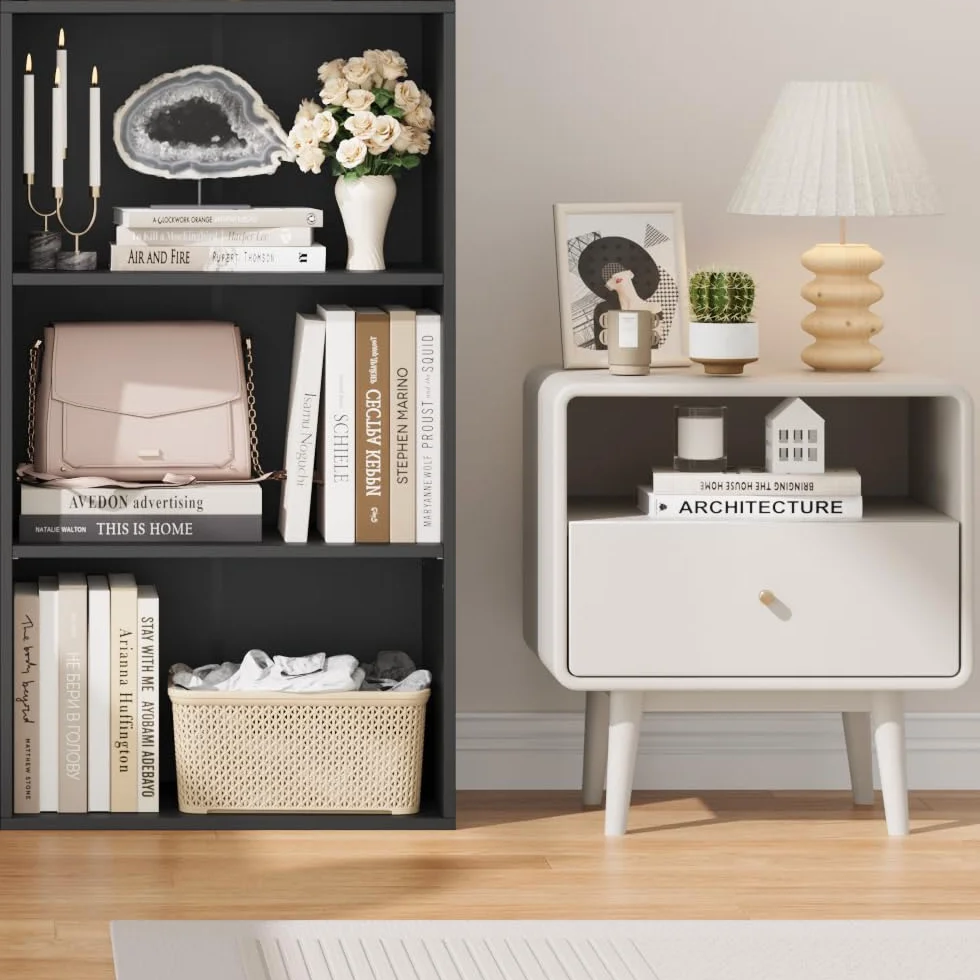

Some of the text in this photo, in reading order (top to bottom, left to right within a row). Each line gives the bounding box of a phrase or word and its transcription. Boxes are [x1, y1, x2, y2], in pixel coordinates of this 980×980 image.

[190, 216, 213, 224] ORANGE
[128, 249, 191, 265] AIR AND FIRE
[212, 250, 239, 264] RUPERT
[421, 334, 434, 373] SQUID
[396, 367, 409, 485] STEPHEN MARINO
[422, 400, 434, 450] PROUST
[295, 393, 317, 488] Isamu Noguchi
[333, 413, 349, 484] SCHIELE
[423, 454, 432, 478] WOLF
[700, 481, 814, 491] BRINGING THE HOUSE HOME
[69, 494, 205, 512] AVEDON advertising
[423, 480, 432, 527] MARYANNE
[678, 500, 844, 514] ARCHITECTURE
[35, 526, 87, 534] NATALIE WALTON
[96, 522, 194, 536] THIS IS HOME
[21, 614, 34, 642] The
[65, 651, 81, 670] НЕ
[65, 673, 81, 709] БЕРИ
[116, 628, 134, 773] Arianna Huffington
[65, 712, 81, 722] В
[141, 616, 155, 798] STAY WITH ME AYOBAMI ADEBAYO
[65, 724, 81, 781] ГОЛОВУ
[24, 738, 32, 801] MATTHEW STONE
